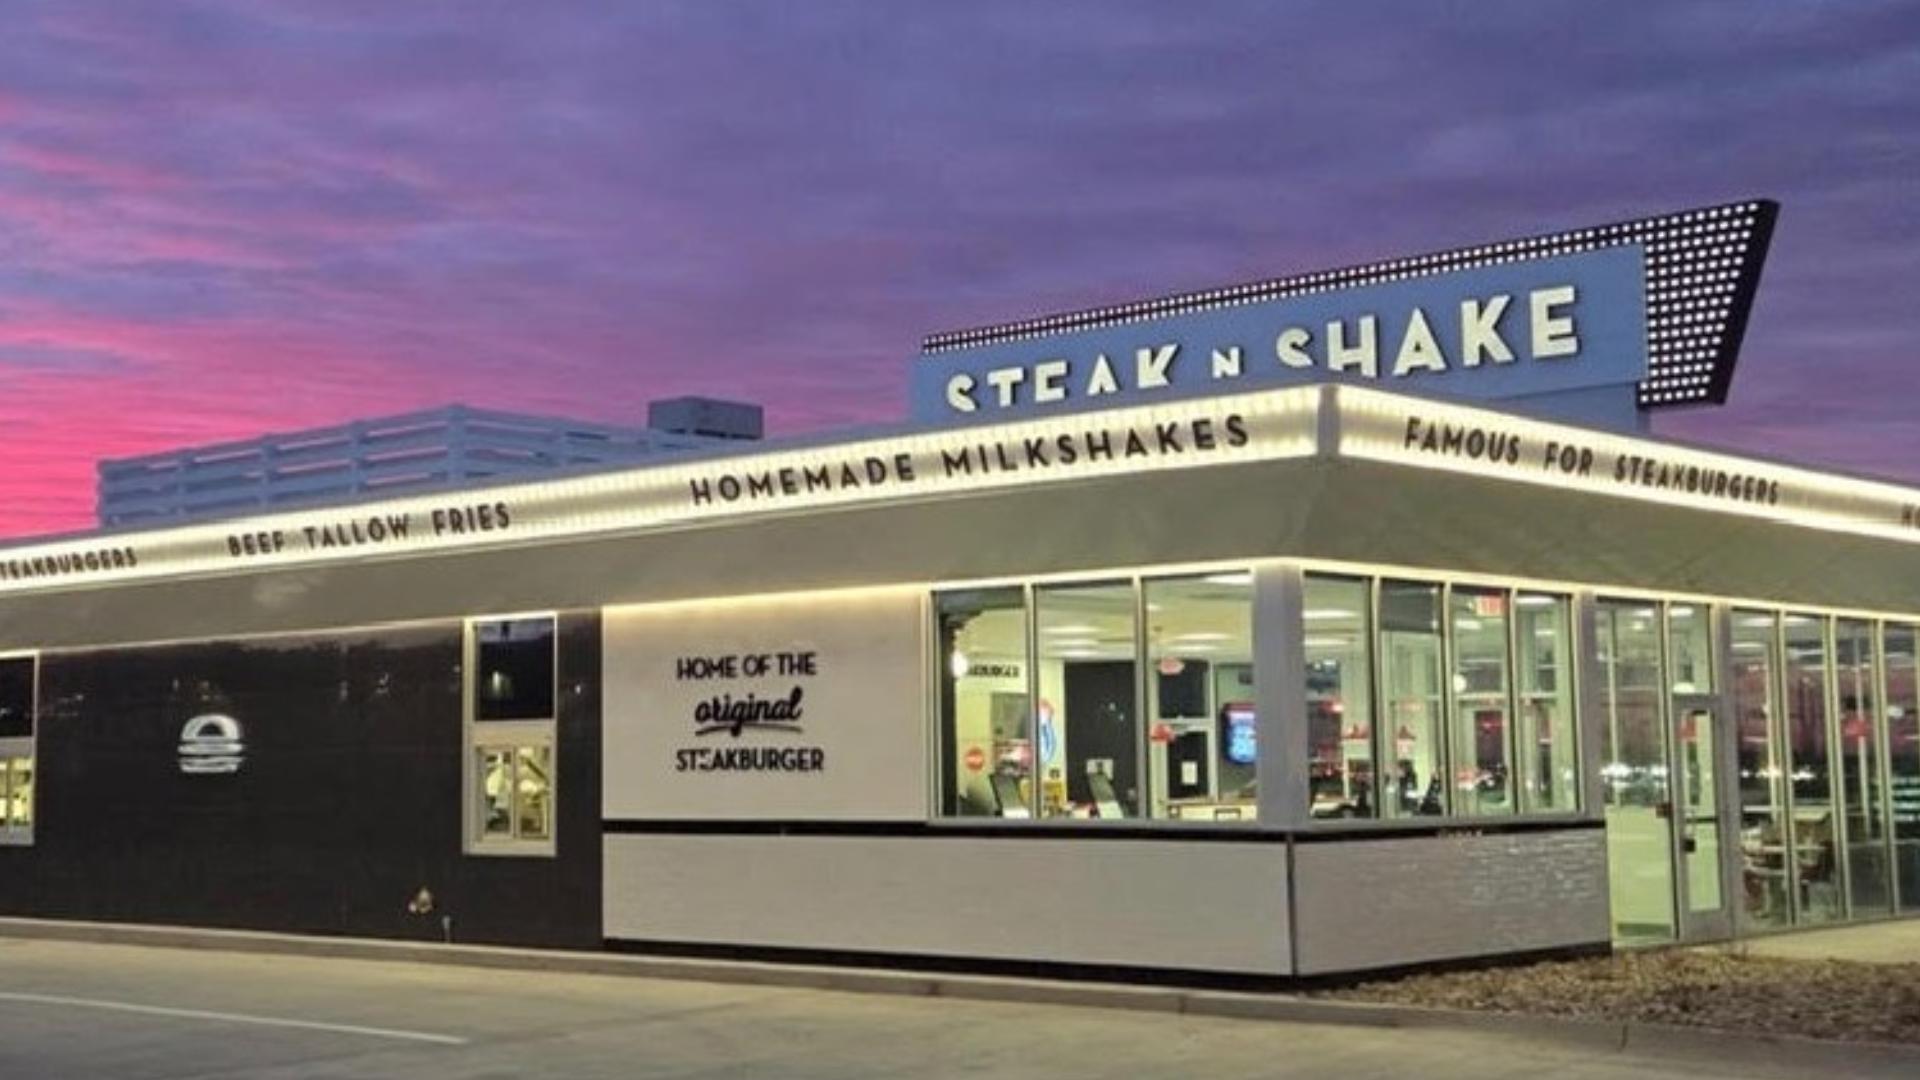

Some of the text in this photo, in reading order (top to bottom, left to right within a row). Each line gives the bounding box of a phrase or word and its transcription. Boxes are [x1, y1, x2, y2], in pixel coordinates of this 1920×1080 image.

[947, 285, 1579, 412] STEAK N SHAKE
[690, 414, 1250, 506] HOMEMADE MILKSHAKES
[1404, 416, 1780, 506] FAMOUS FOR STEAKBURGERS
[227, 502, 510, 558] BEEF TALLOW FRIES
[676, 651, 817, 680] HOME OF THE
[694, 685, 804, 738] original
[675, 747, 825, 772] STEAKBURGER
